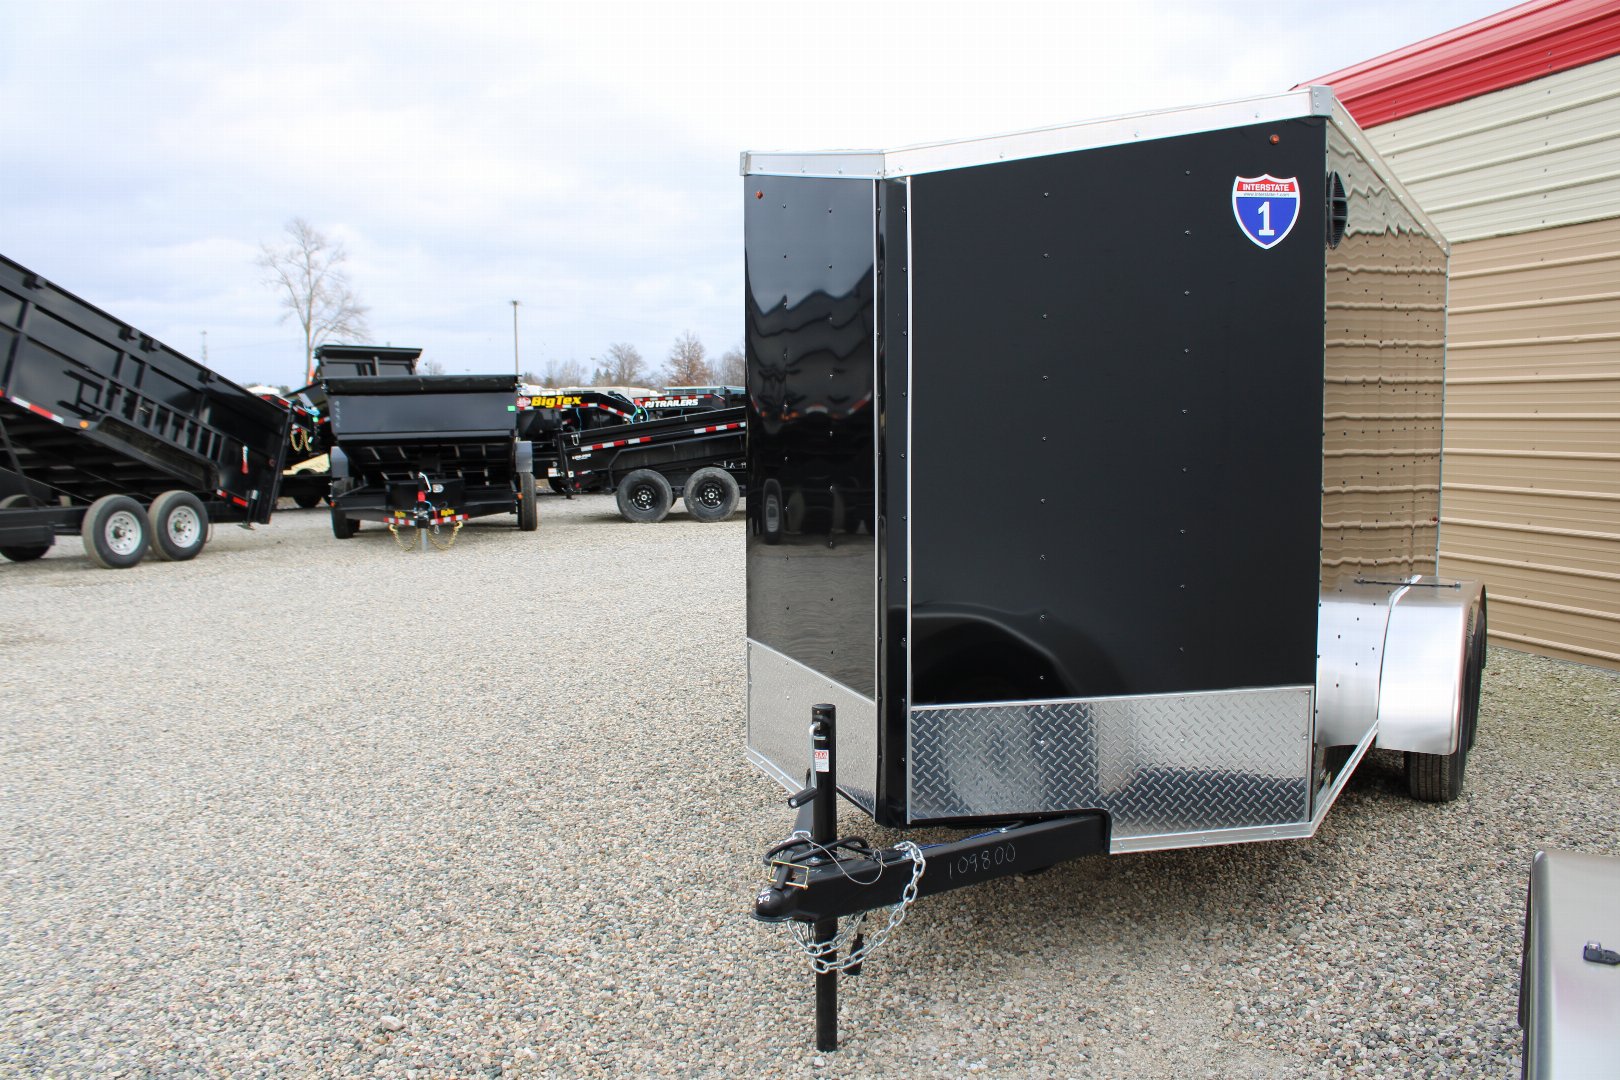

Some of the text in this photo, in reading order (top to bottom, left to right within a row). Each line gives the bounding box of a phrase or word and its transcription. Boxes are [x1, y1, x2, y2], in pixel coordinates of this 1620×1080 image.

[1242, 183, 1290, 192] INTERSTATE
[1257, 201, 1275, 236] 1
[949, 842, 1016, 880] 109800
